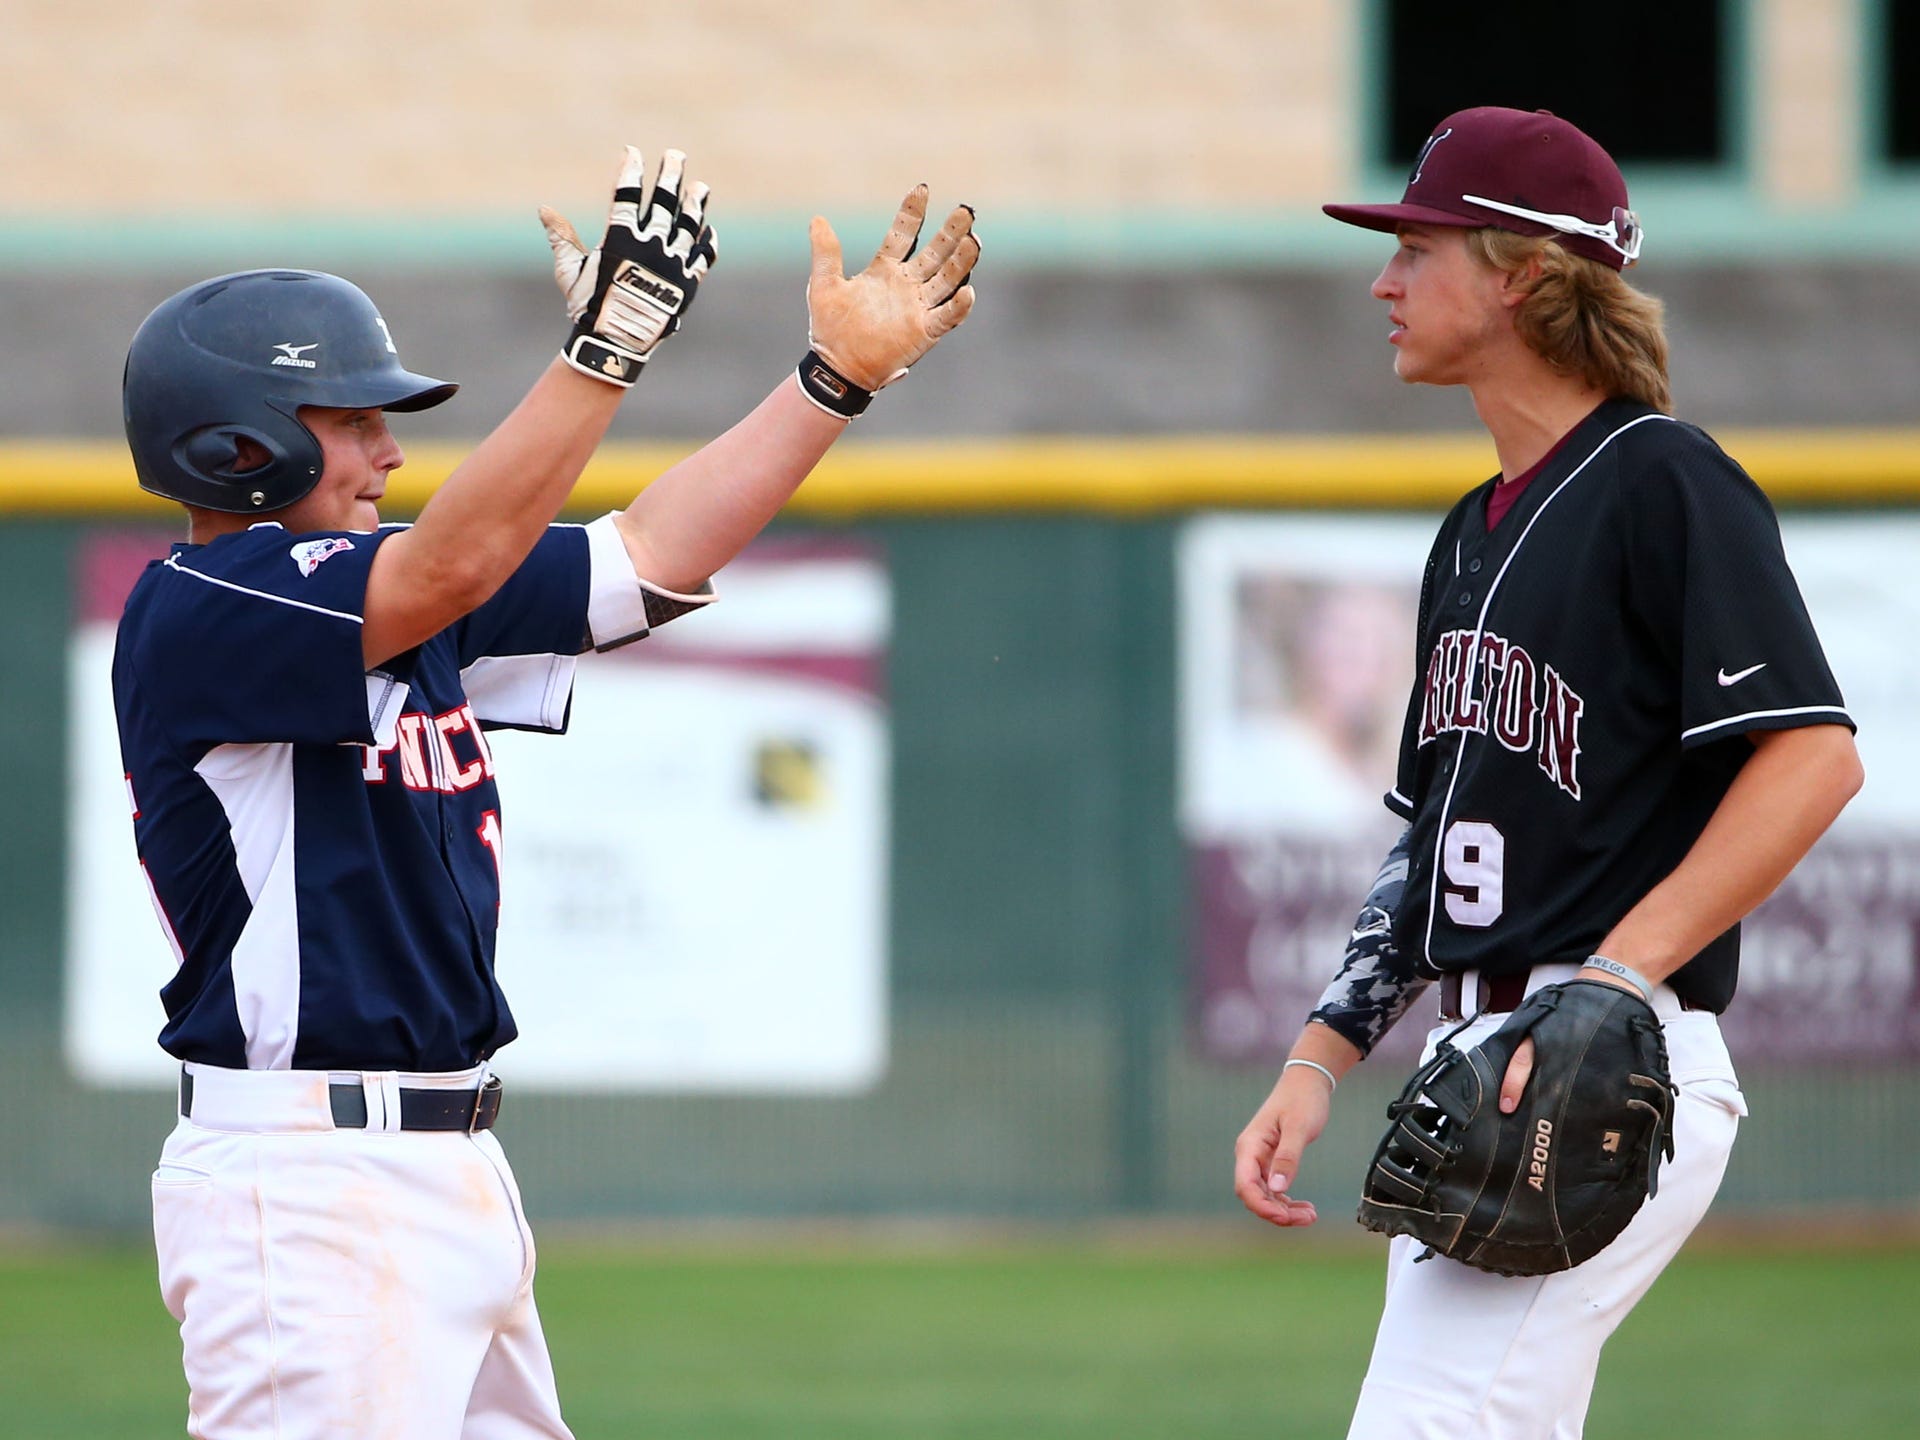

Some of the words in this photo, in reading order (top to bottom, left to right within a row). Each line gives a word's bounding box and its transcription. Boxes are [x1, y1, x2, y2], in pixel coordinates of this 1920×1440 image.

[1443, 820, 1505, 928] 9
[1609, 962, 1626, 975] GO
[1528, 1118, 1553, 1192] A2000
